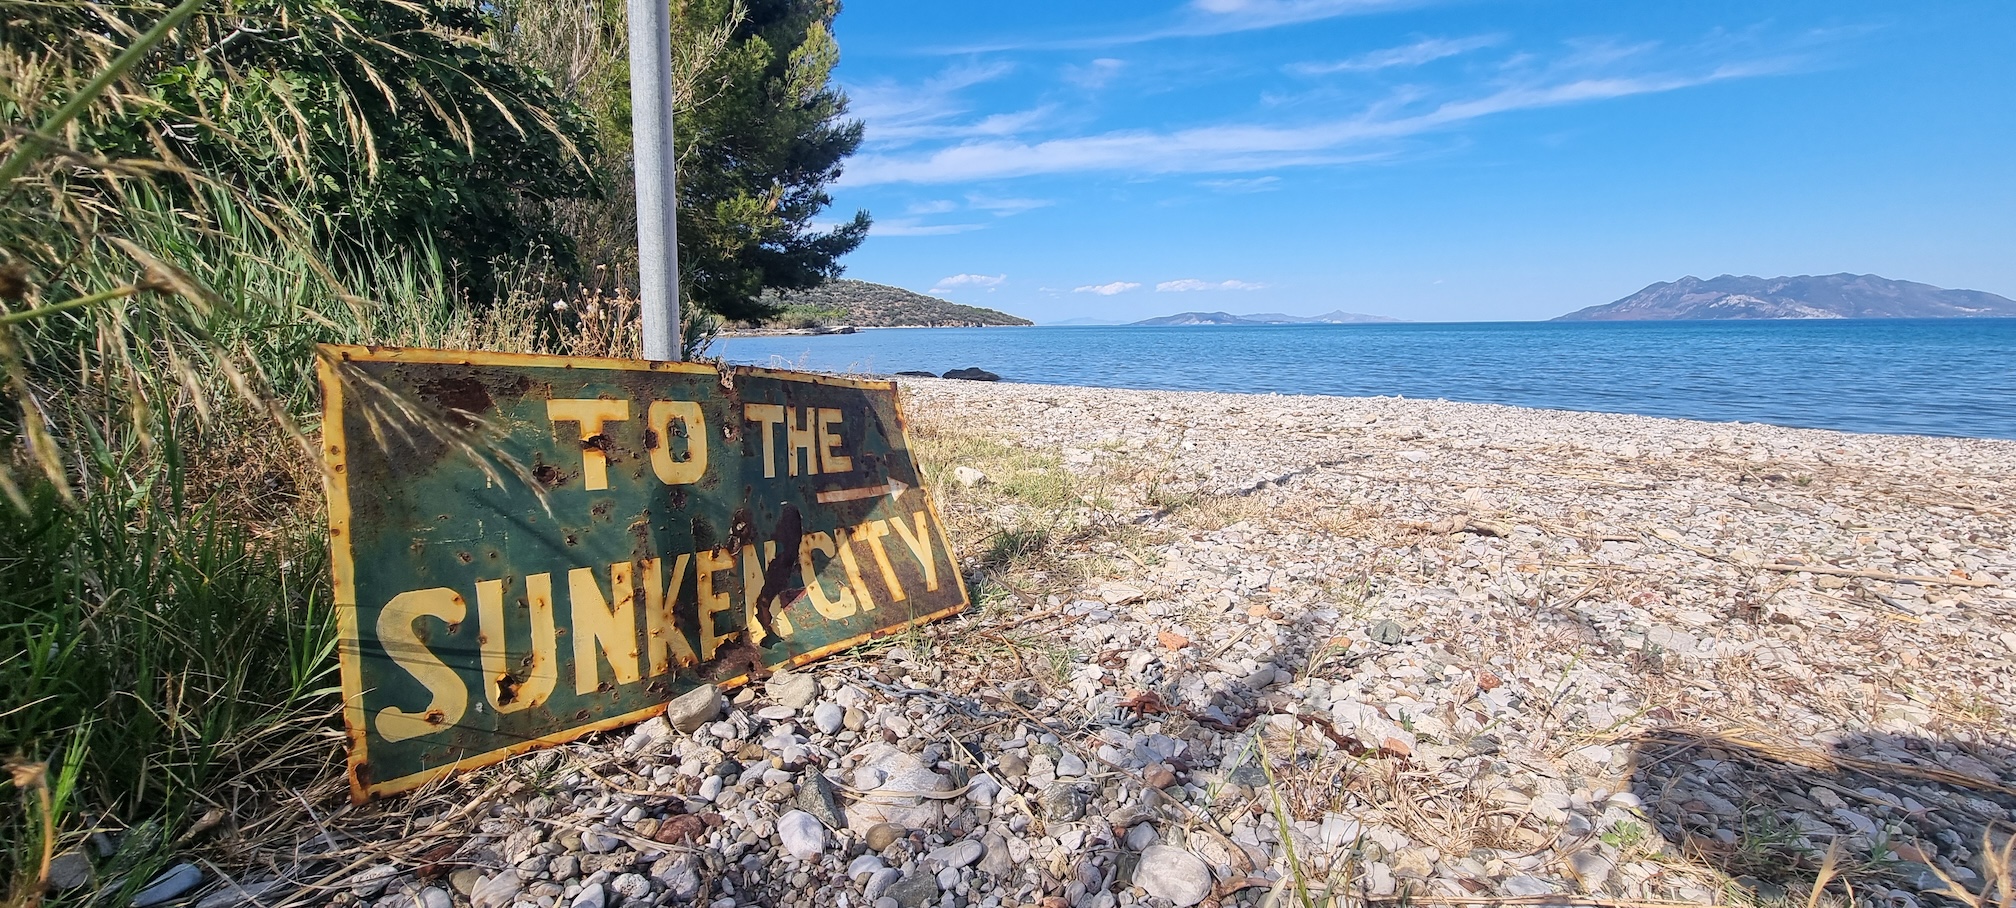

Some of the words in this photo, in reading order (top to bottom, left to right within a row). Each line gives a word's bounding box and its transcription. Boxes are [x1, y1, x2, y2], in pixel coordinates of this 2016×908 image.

[546, 399, 708, 491] TO
[744, 403, 853, 478] THE
[375, 540, 794, 742] SUNKEN
[799, 510, 938, 620] CITY
